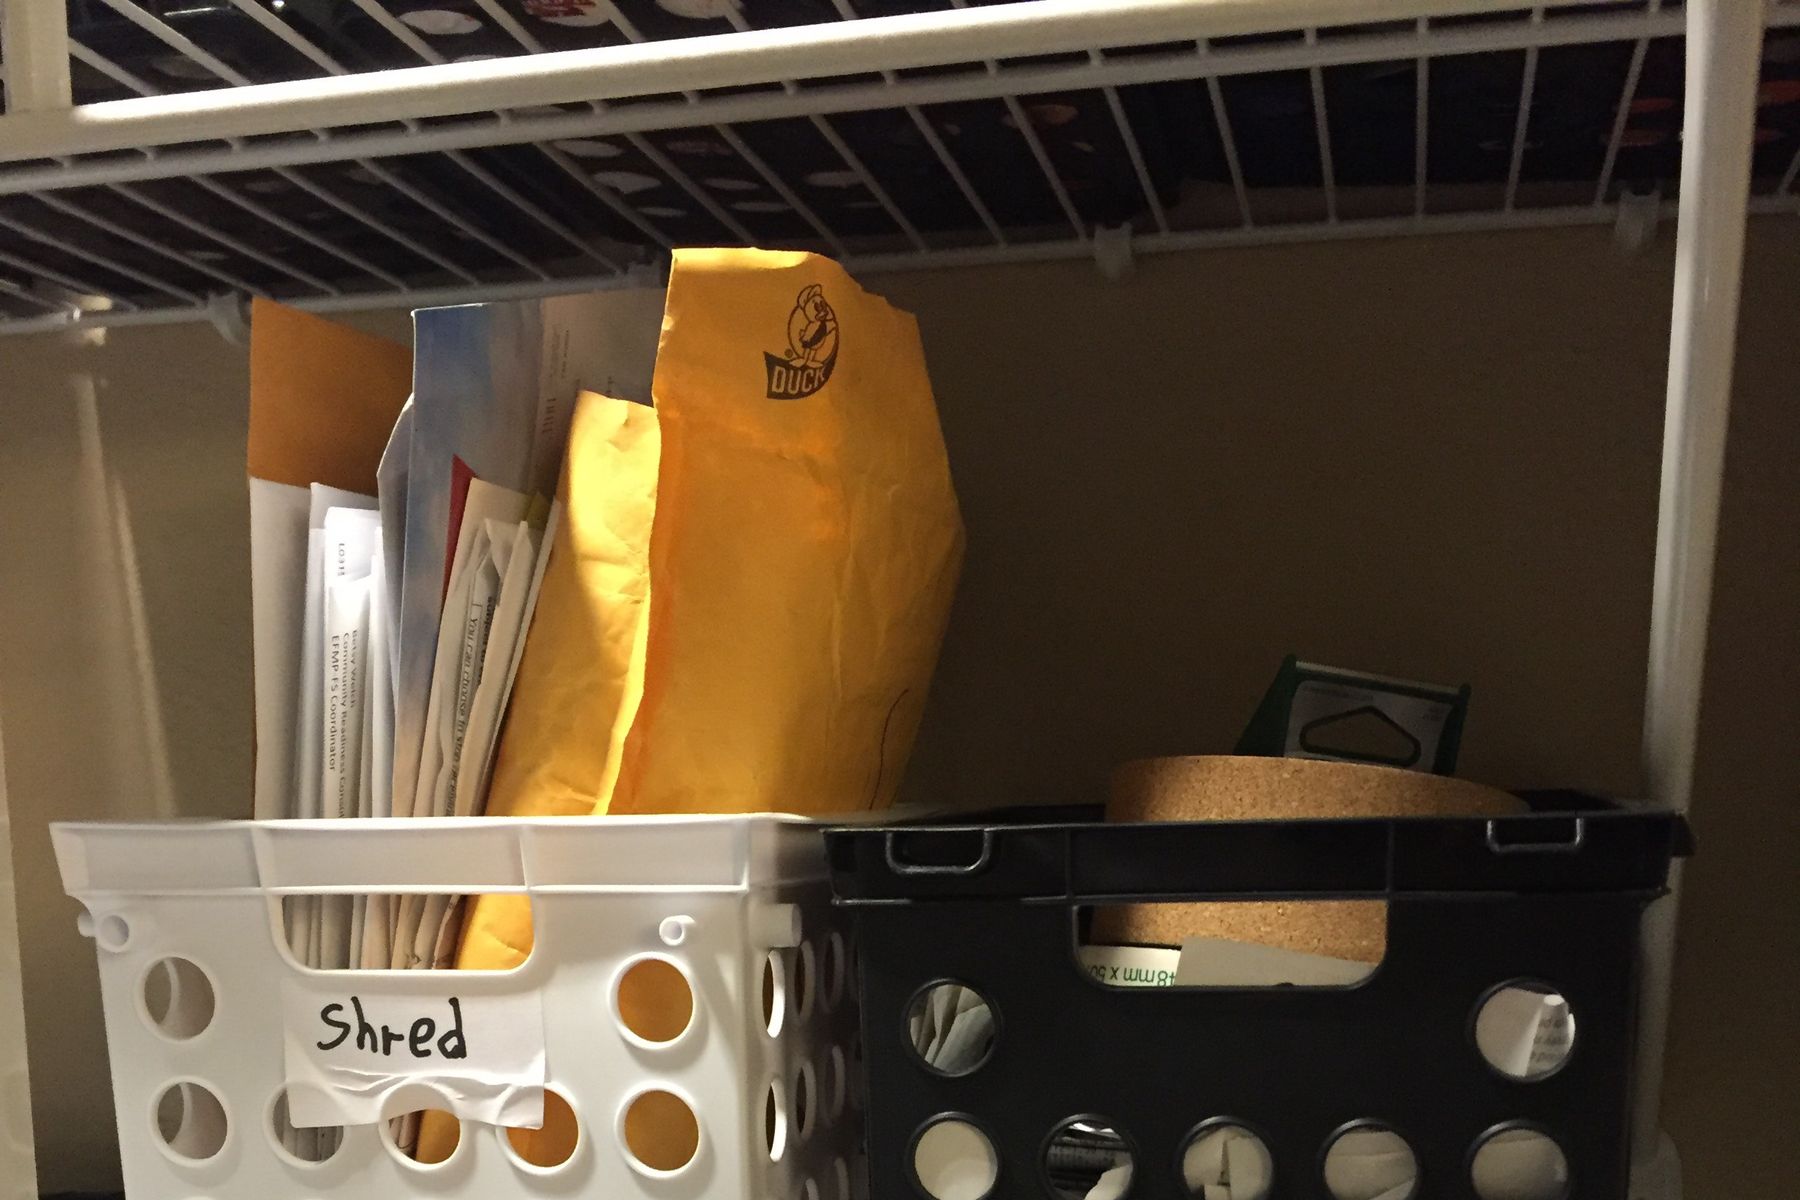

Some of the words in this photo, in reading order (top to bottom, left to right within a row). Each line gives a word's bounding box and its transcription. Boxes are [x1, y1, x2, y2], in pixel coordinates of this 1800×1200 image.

[771, 365, 824, 394] DUCK
[467, 618, 478, 640] You
[341, 632, 350, 707] Community
[463, 644, 473, 668] can
[460, 670, 470, 716] choose
[329, 695, 338, 771] Coordinator
[316, 996, 467, 1059] Shred
